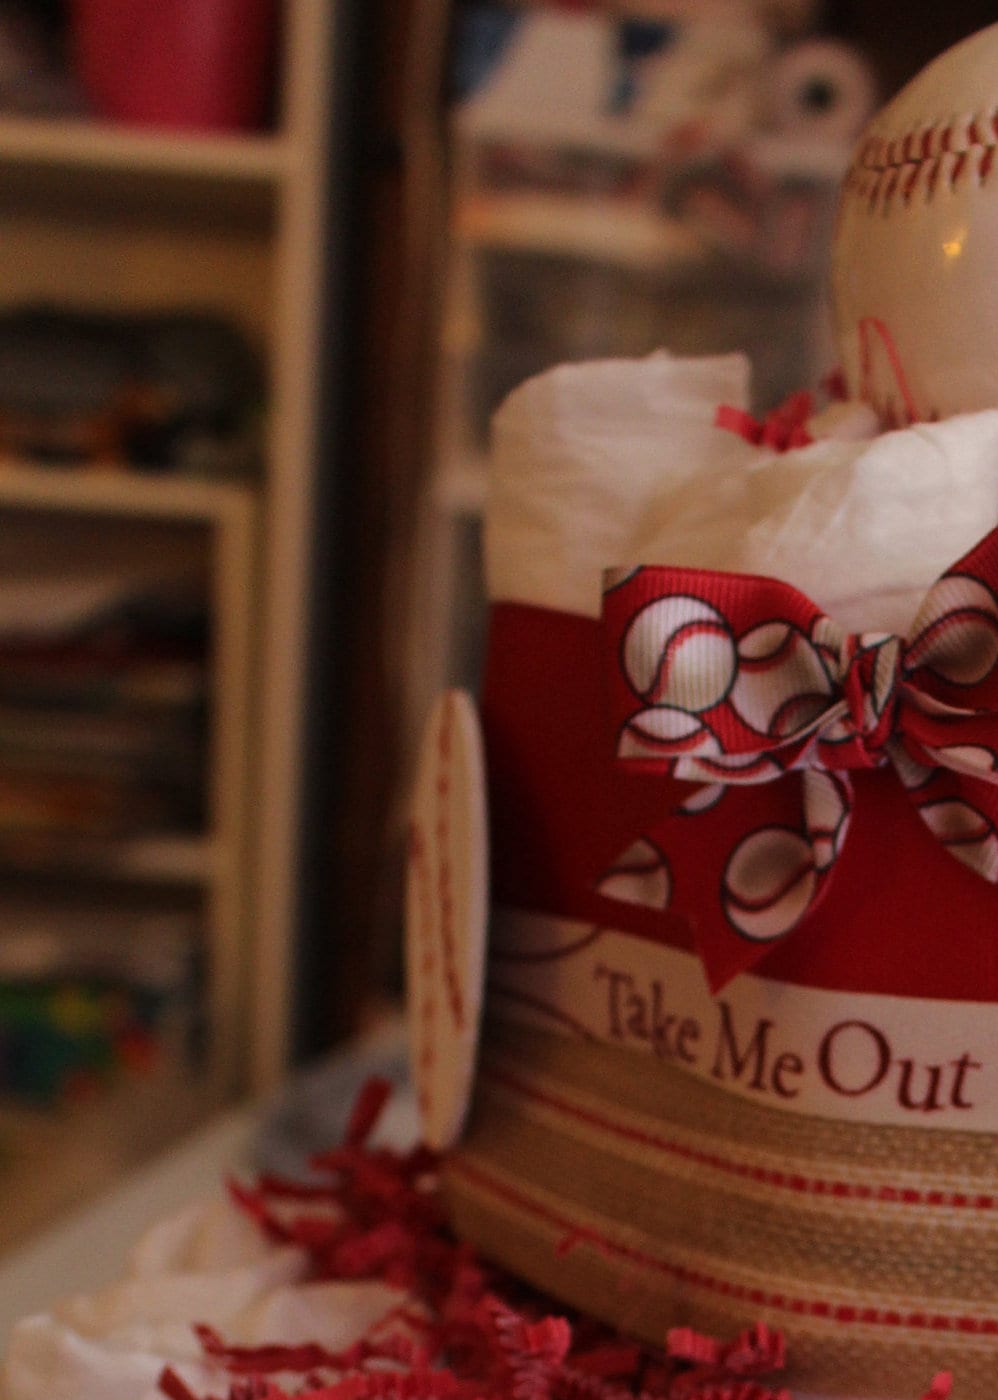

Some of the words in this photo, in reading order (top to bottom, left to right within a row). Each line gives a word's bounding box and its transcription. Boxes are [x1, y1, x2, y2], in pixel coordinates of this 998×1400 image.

[594, 962, 700, 1062] Take
[712, 1001, 805, 1097] Me
[817, 1019, 981, 1112] Out
